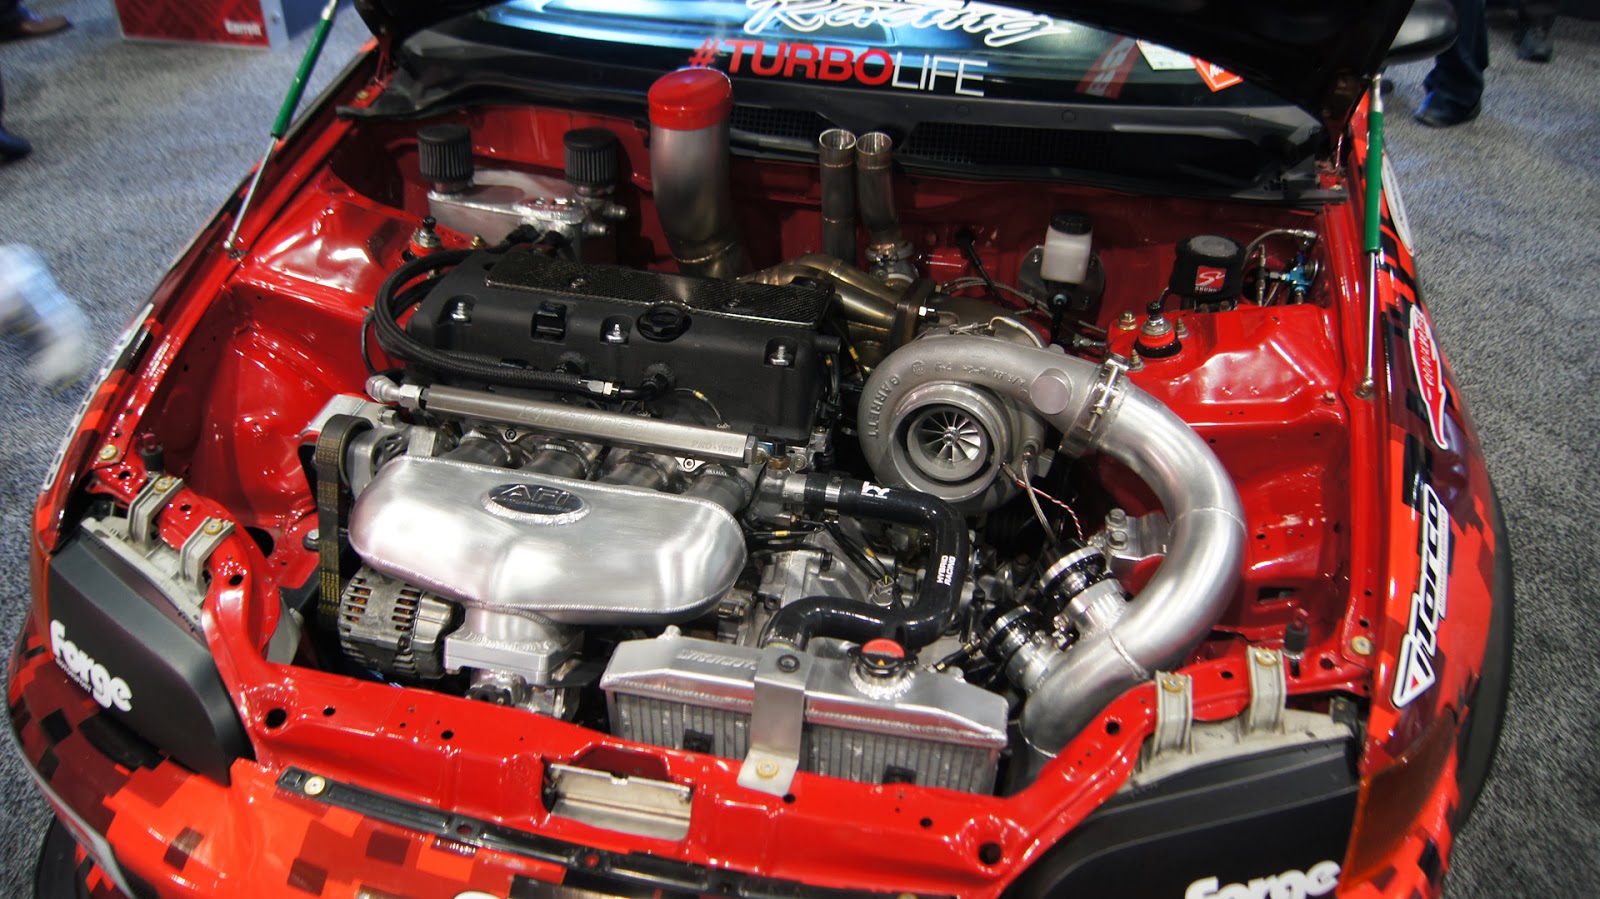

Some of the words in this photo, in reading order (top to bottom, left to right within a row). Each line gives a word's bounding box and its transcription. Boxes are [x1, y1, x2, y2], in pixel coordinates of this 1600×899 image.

[688, 38, 988, 97] #TURBOLIFE
[944, 555, 956, 586] RACING
[50, 619, 133, 711] Forge
